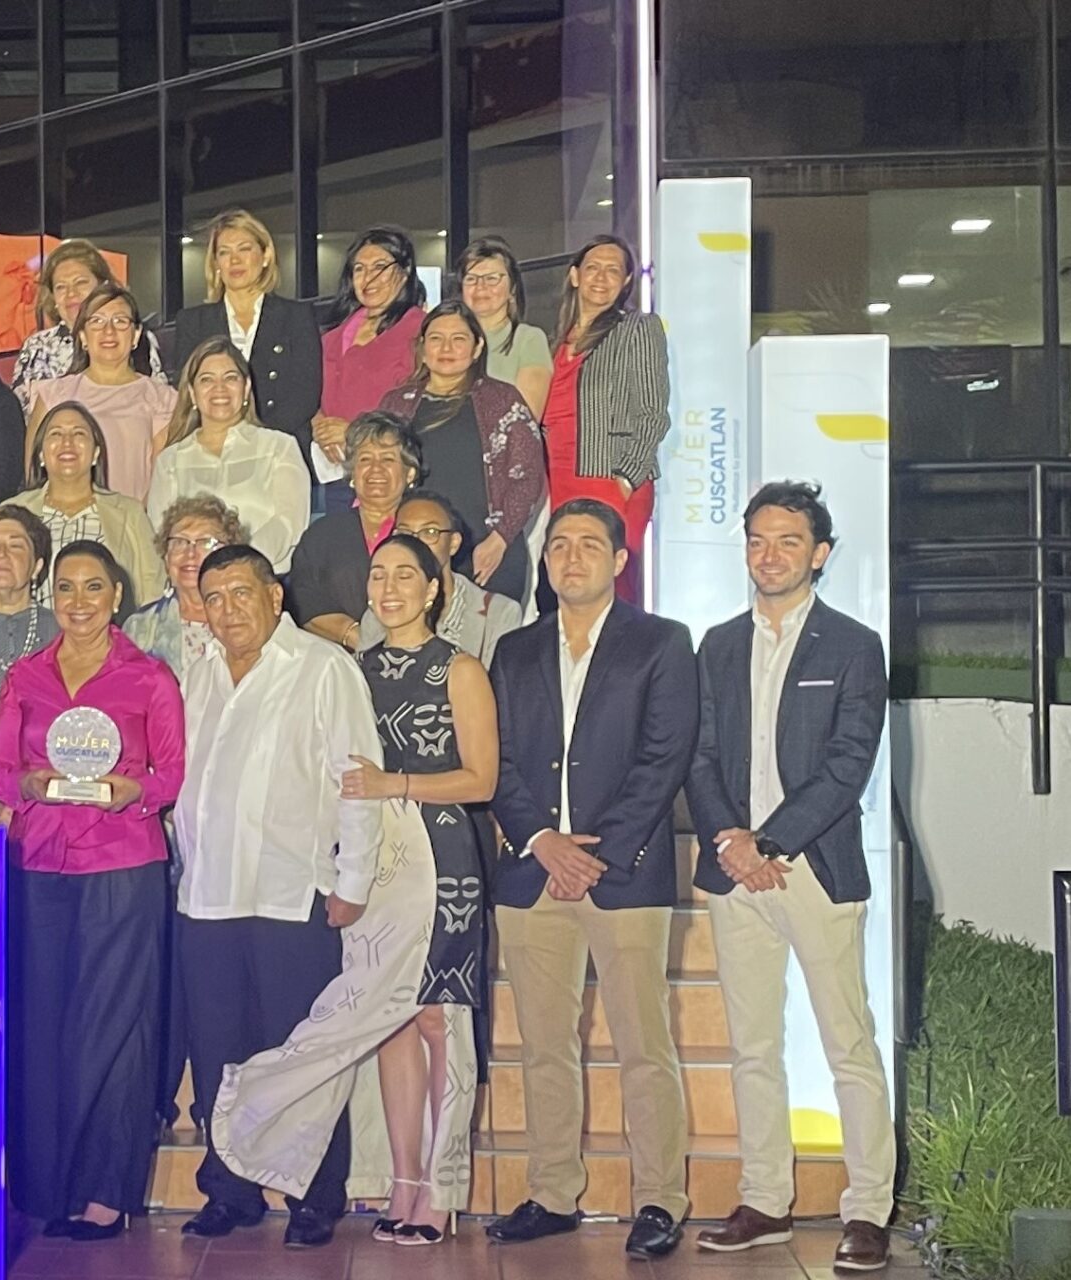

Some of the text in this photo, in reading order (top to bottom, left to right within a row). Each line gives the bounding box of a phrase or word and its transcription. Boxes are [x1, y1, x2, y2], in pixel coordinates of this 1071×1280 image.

[685, 410, 705, 523] MUJER
[710, 407, 726, 524] CUSCATLAN
[55, 747, 110, 759] CUSCATLAN
[56, 735, 110, 749] MUJER
